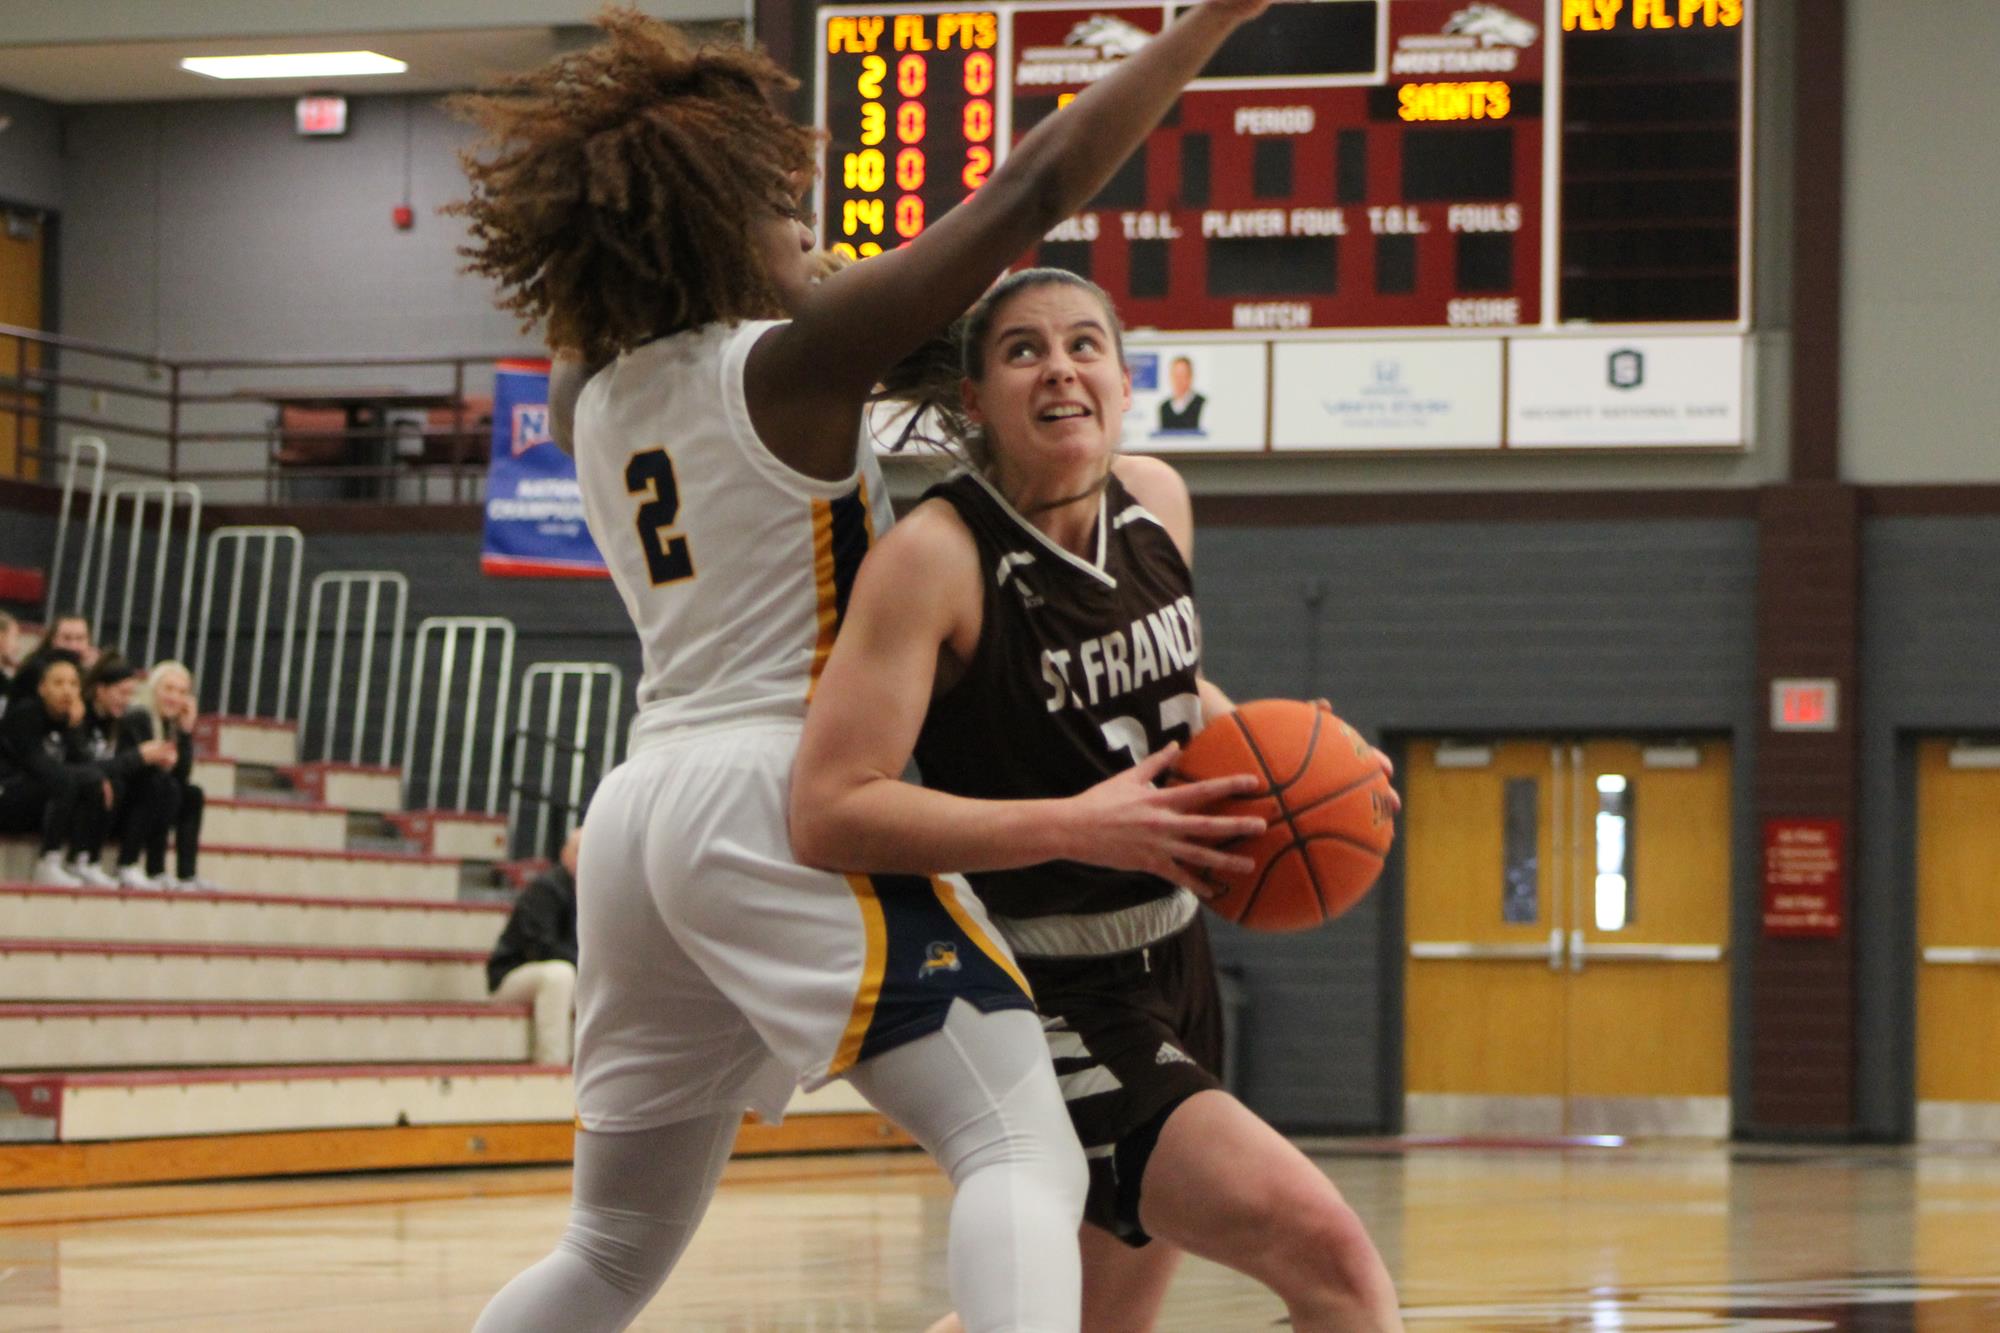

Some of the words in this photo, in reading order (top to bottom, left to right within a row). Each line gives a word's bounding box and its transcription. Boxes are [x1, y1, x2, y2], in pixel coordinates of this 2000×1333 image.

[894, 14, 933, 51] FL
[937, 12, 997, 50] PTS
[1679, 0, 1743, 28] PTS
[858, 55, 887, 99] 2
[897, 53, 927, 98] 0
[963, 51, 993, 96] 0
[1234, 106, 1316, 135] PERIOD
[1398, 81, 1511, 121] SAINTS
[860, 102, 886, 146] 3
[896, 100, 926, 144] 0
[963, 99, 993, 142] 0
[843, 148, 886, 192] 10
[895, 147, 925, 191] 0
[962, 145, 992, 190] 2
[843, 198, 885, 236] 14
[895, 194, 924, 238] 0
[1202, 209, 1286, 238] PLAYER
[1290, 208, 1348, 236] FOUL
[1447, 203, 1522, 233] FOULS
[1232, 303, 1312, 329] MATCH
[1447, 298, 1521, 326] SCORE
[625, 446, 695, 588] 2
